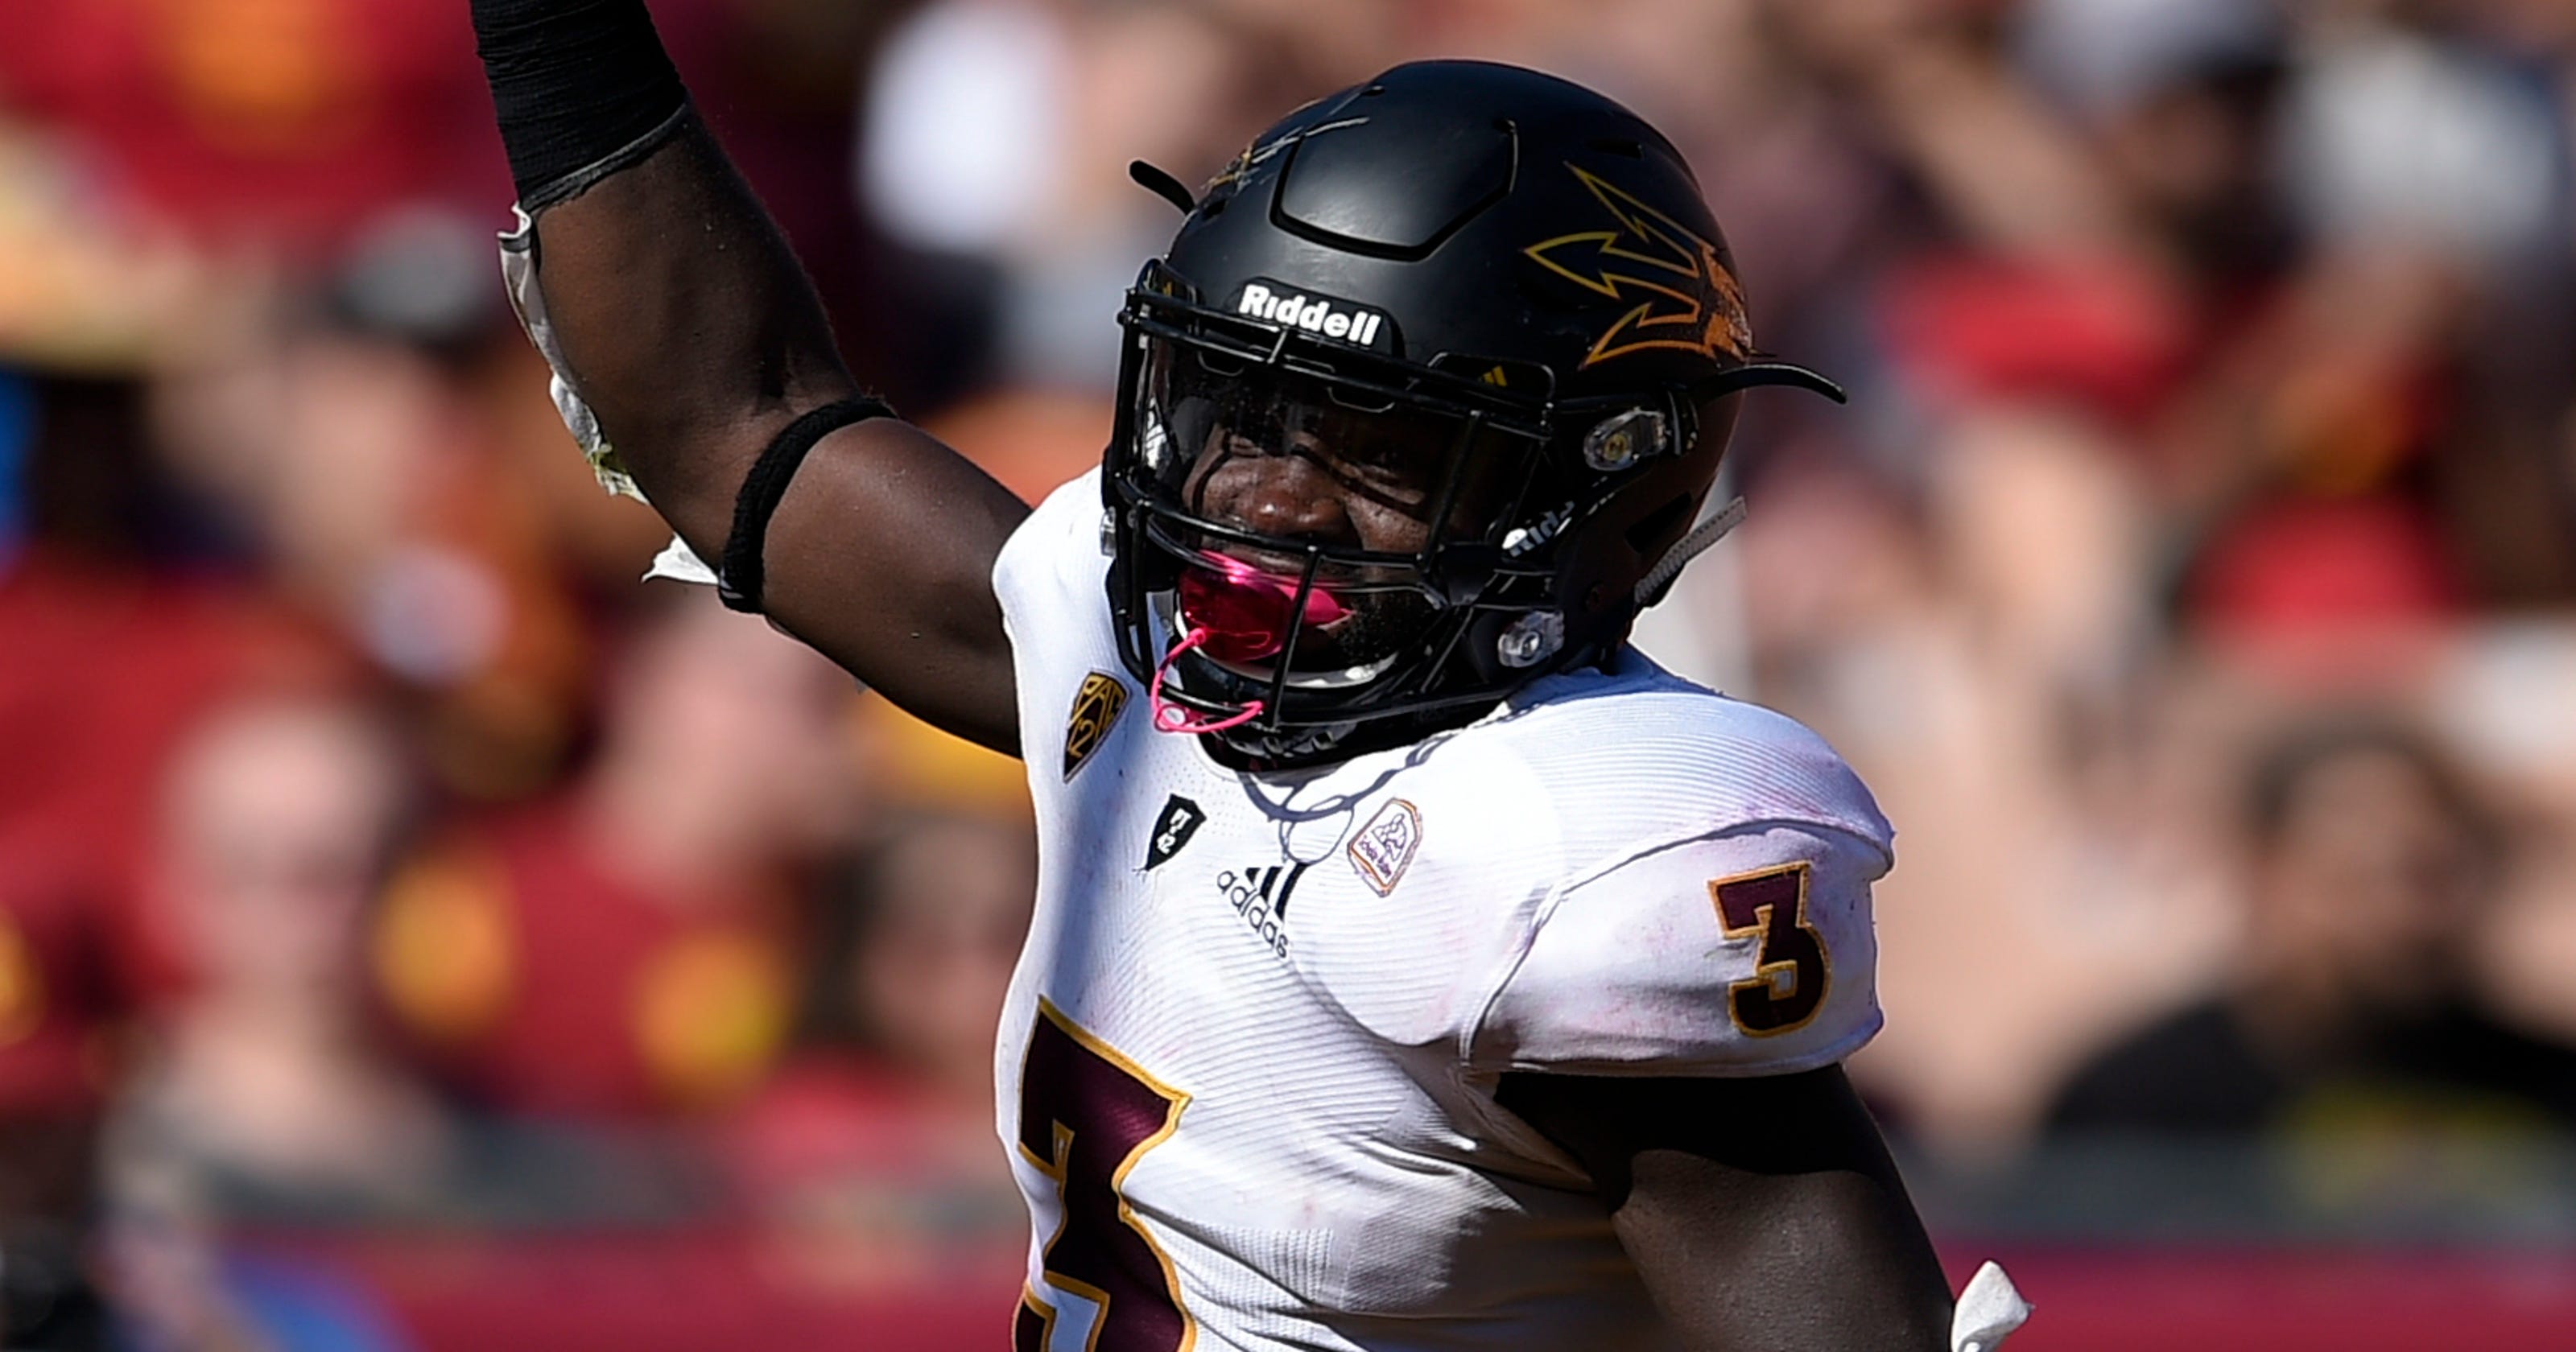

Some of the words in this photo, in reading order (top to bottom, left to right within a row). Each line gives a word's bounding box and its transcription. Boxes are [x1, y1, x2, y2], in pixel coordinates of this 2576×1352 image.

[1238, 283, 1381, 346] Riddell
[1216, 870, 1288, 958] adidas
[1707, 859, 1832, 1038] 3
[1013, 994, 1195, 1352] 3
